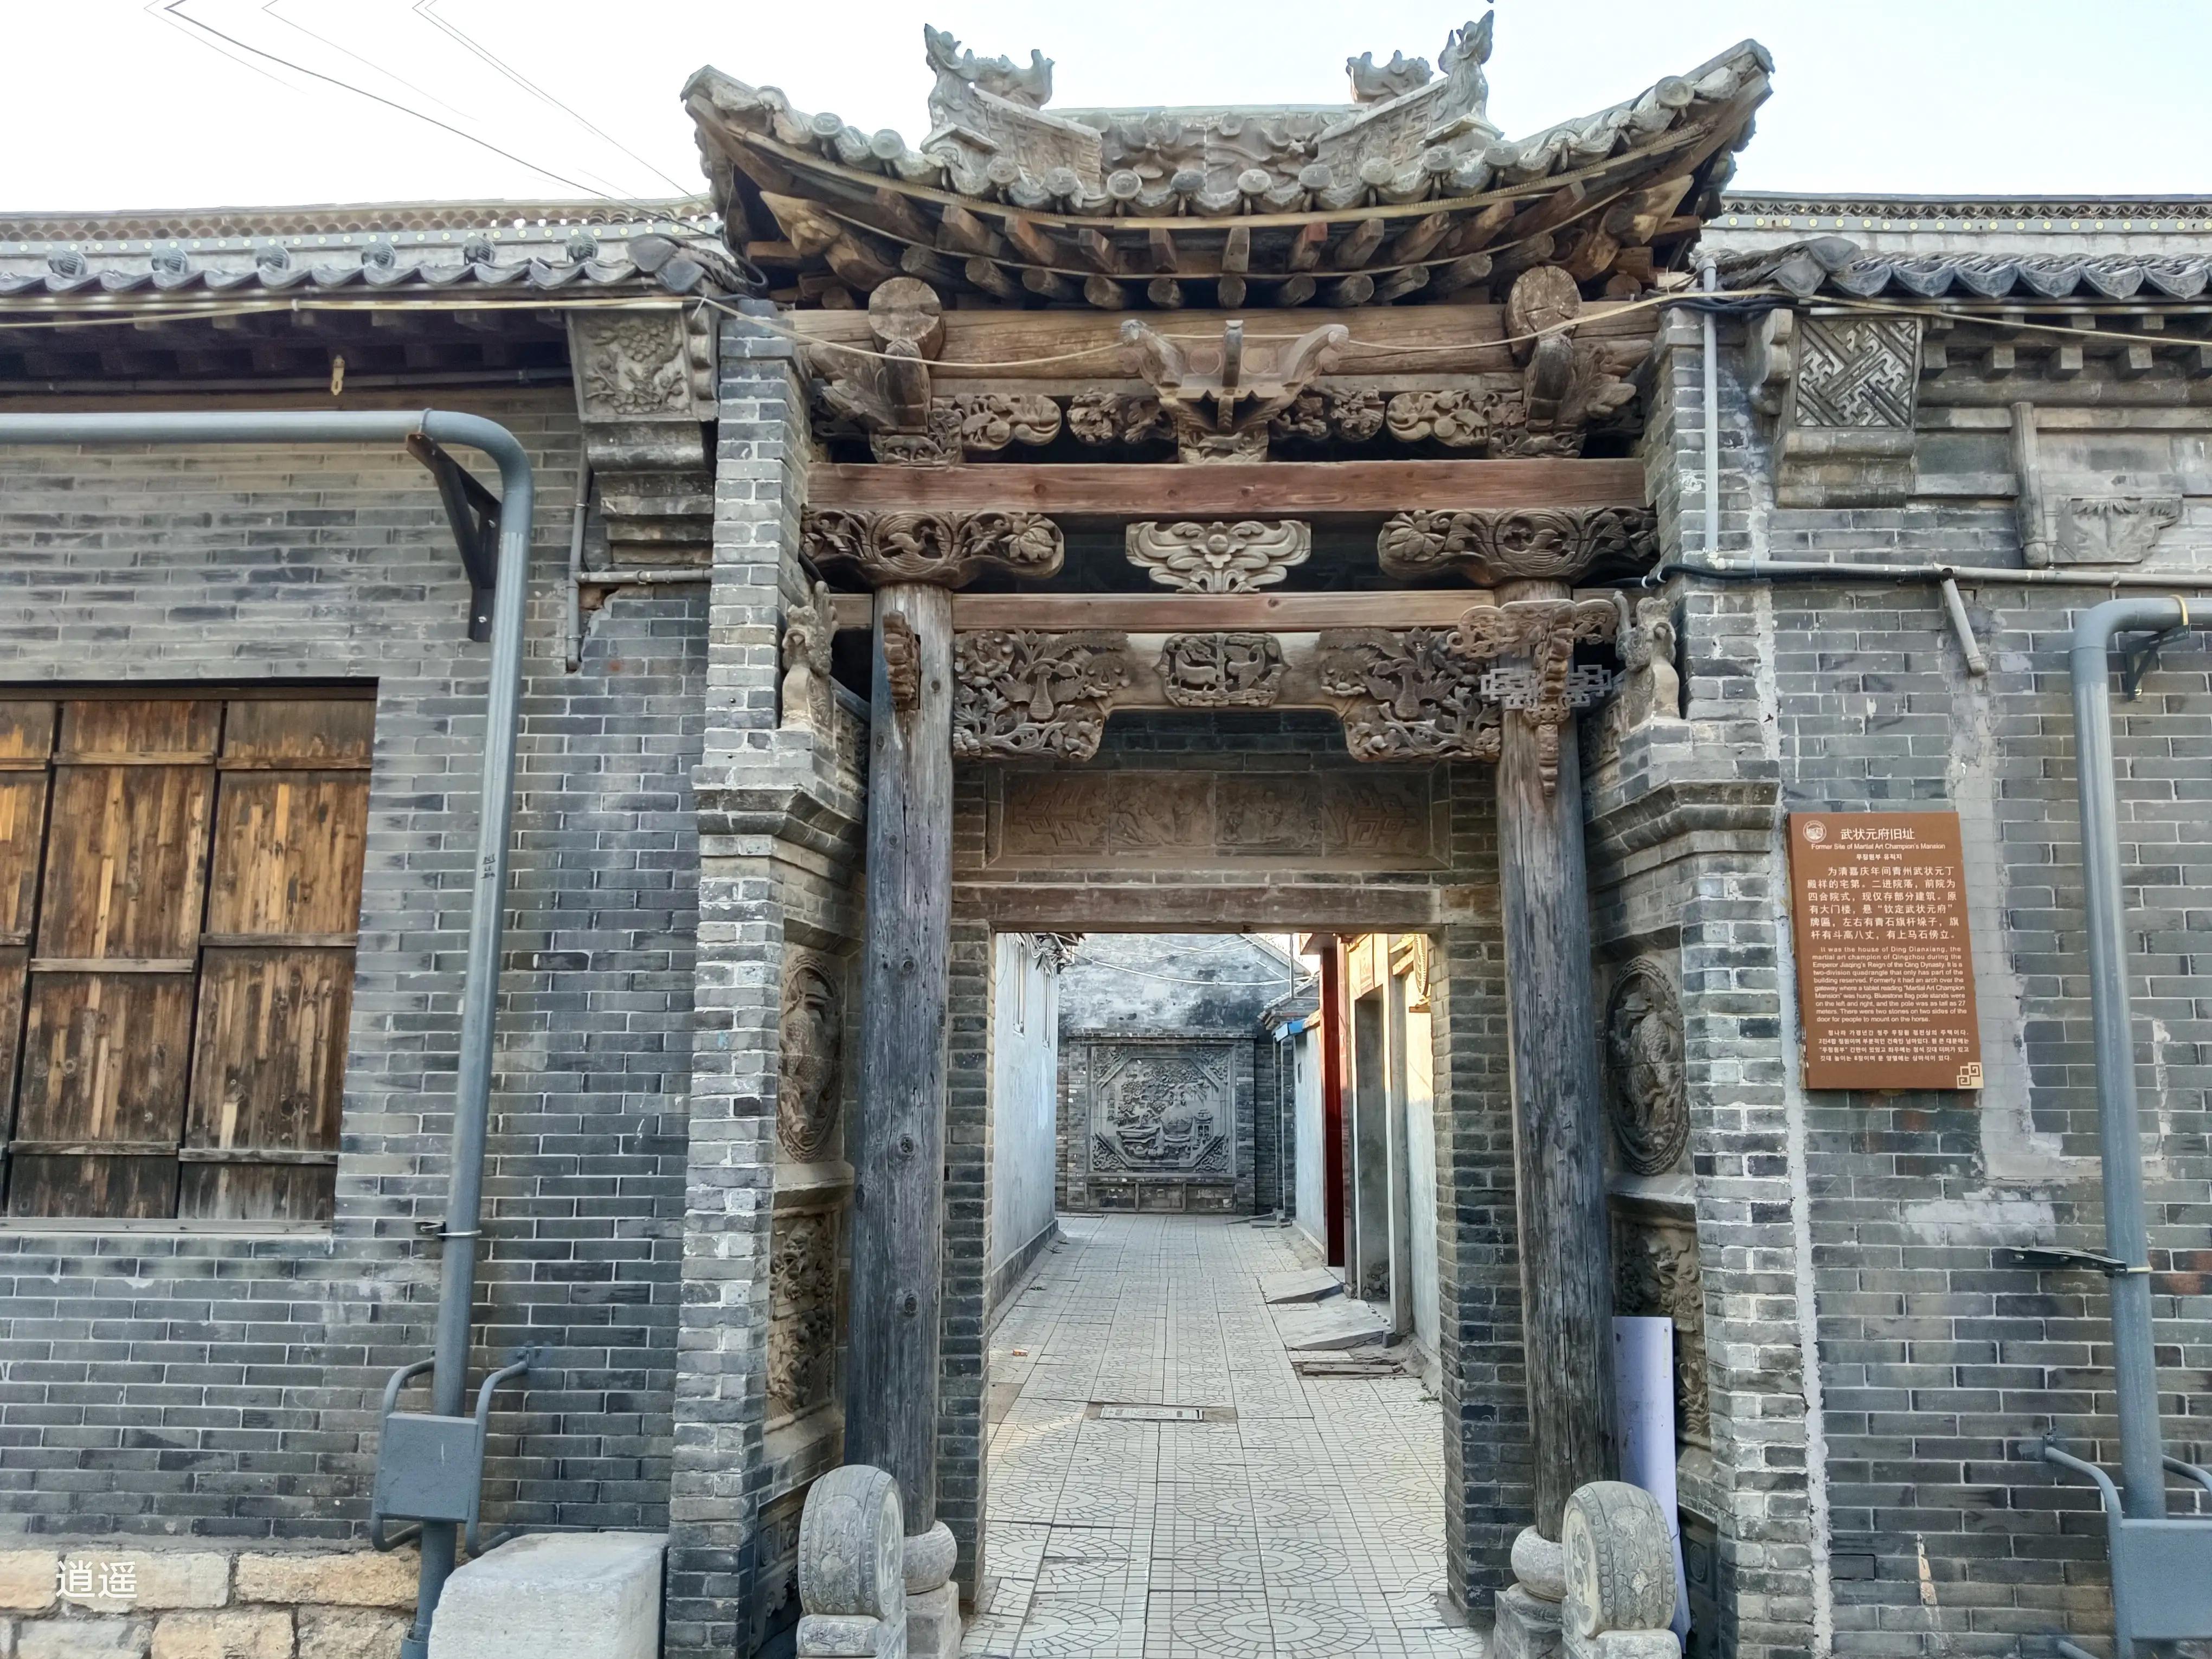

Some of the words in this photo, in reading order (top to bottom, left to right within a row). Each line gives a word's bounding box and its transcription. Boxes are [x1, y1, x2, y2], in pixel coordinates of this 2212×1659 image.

[1841, 827, 1915, 840] 武状元府旧址
[1885, 843, 1919, 851] Champion's
[1828, 866, 1954, 876] 为清嘉庆年间青州武状元丁
[1909, 946, 1947, 954] Dianxiang,
[1868, 961, 1886, 969] Reign
[1905, 992, 1915, 1000] flag
